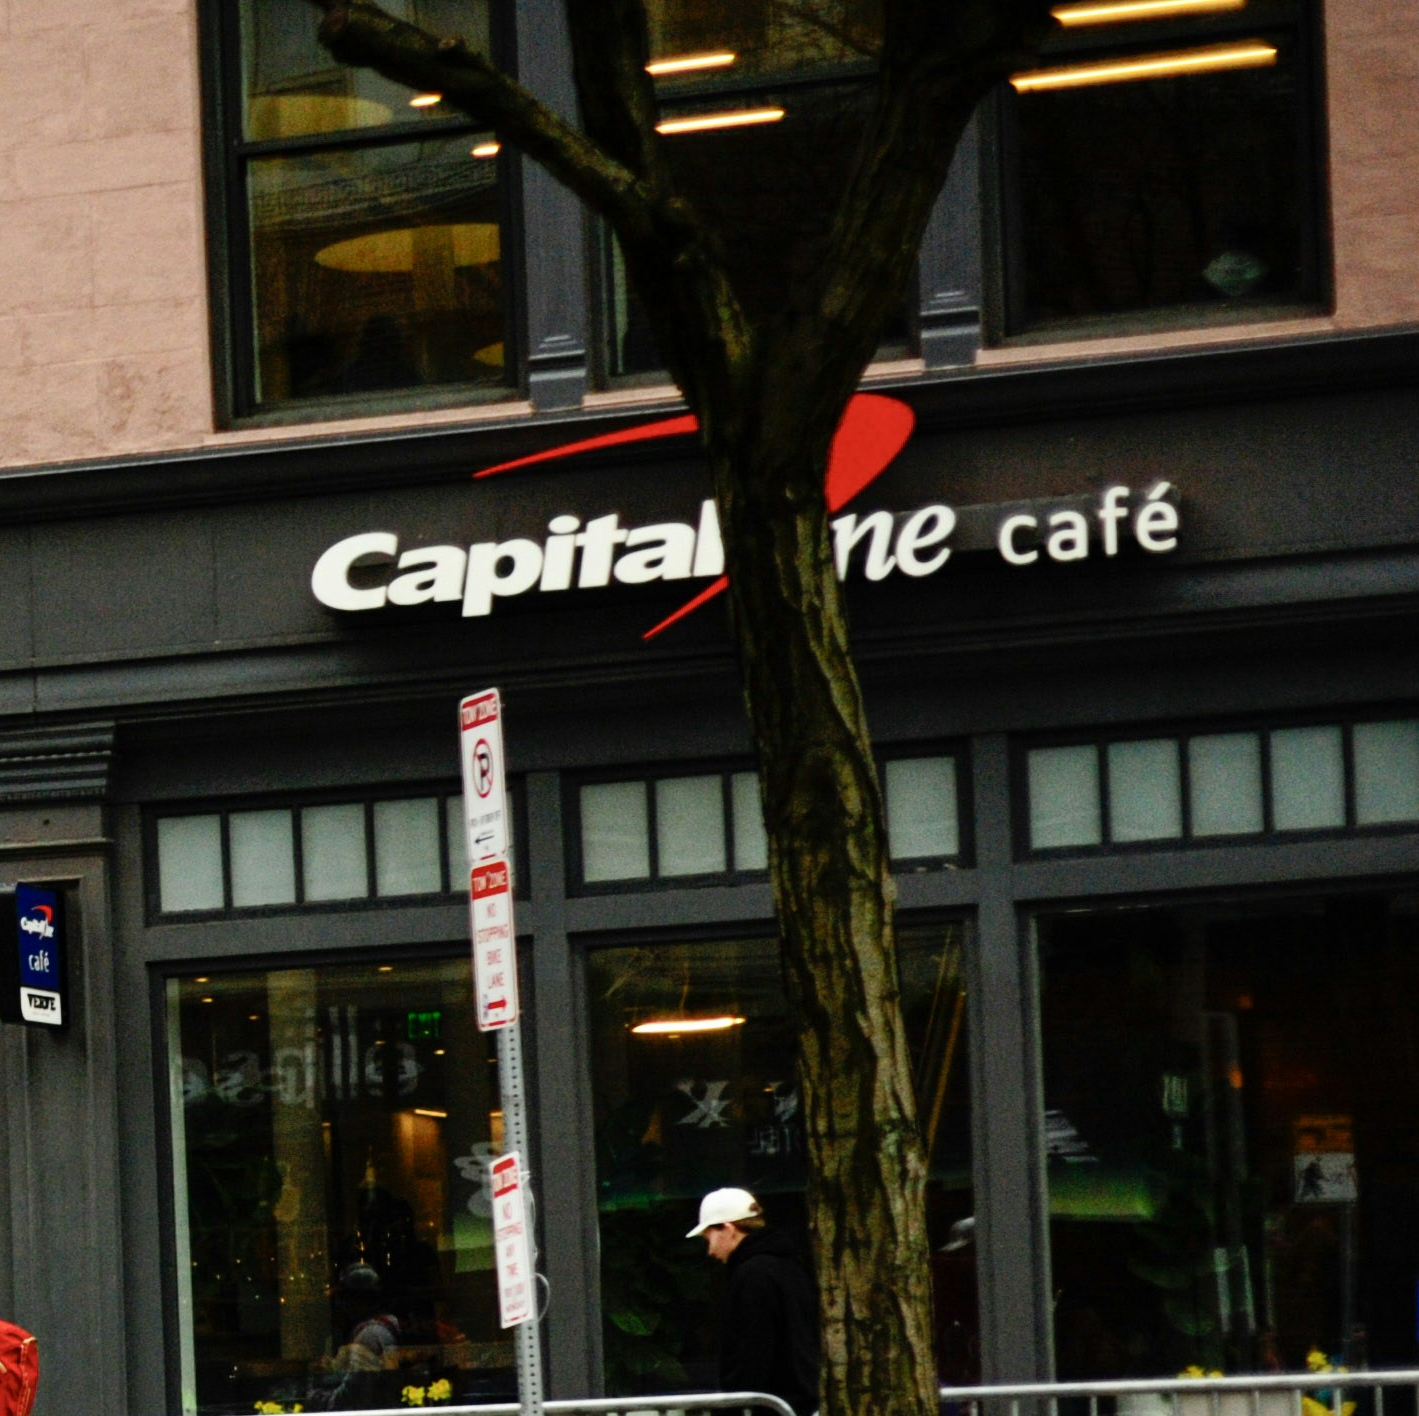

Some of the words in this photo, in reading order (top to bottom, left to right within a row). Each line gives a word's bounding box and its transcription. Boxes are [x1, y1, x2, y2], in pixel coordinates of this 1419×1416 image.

[311, 499, 725, 617] Capital
[831, 505, 956, 582] ne
[999, 481, 1178, 564] café
[473, 876, 486, 892] TOW
[488, 870, 507, 889] ZONE
[28, 950, 50, 973] café
